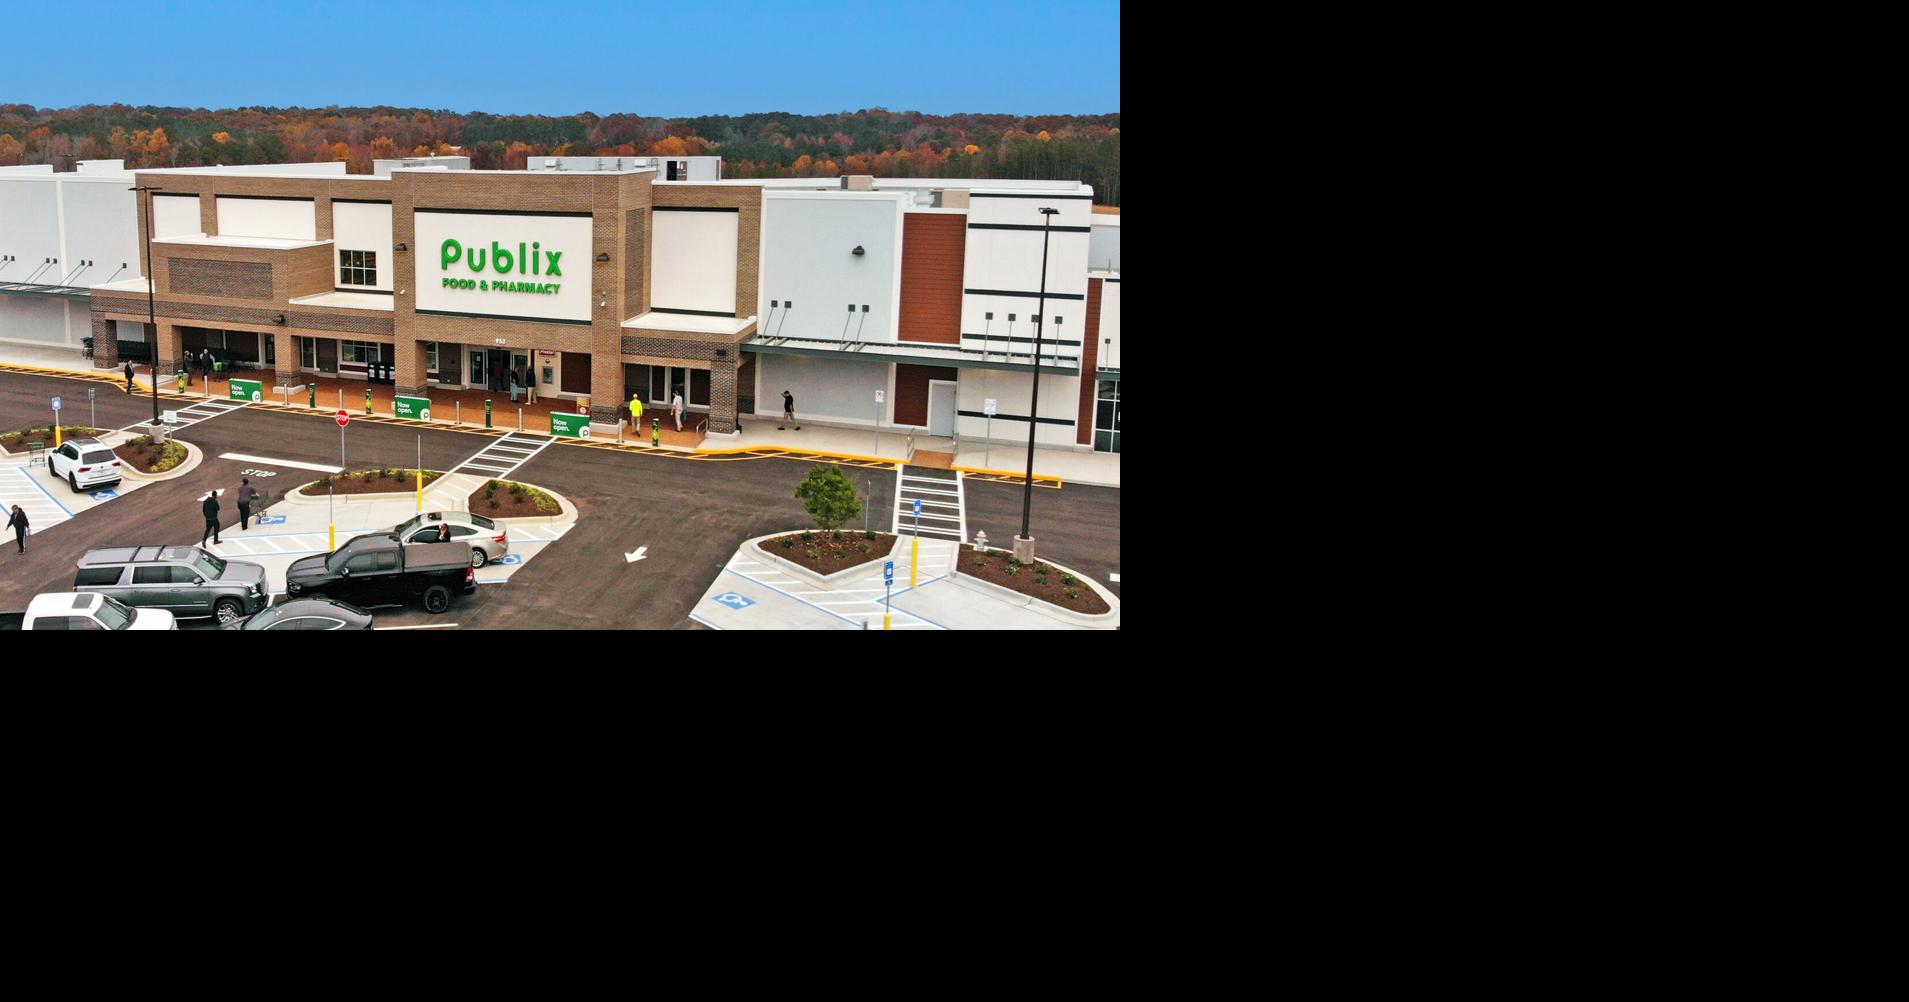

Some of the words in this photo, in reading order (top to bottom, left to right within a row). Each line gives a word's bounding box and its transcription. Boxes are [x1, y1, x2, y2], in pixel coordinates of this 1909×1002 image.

[441, 239, 562, 276] Publix
[442, 278, 476, 290] FOOD
[480, 280, 488, 291] &
[492, 281, 561, 295] PHARMACY
[553, 418, 567, 426] Now
[241, 469, 277, 477] STOP
